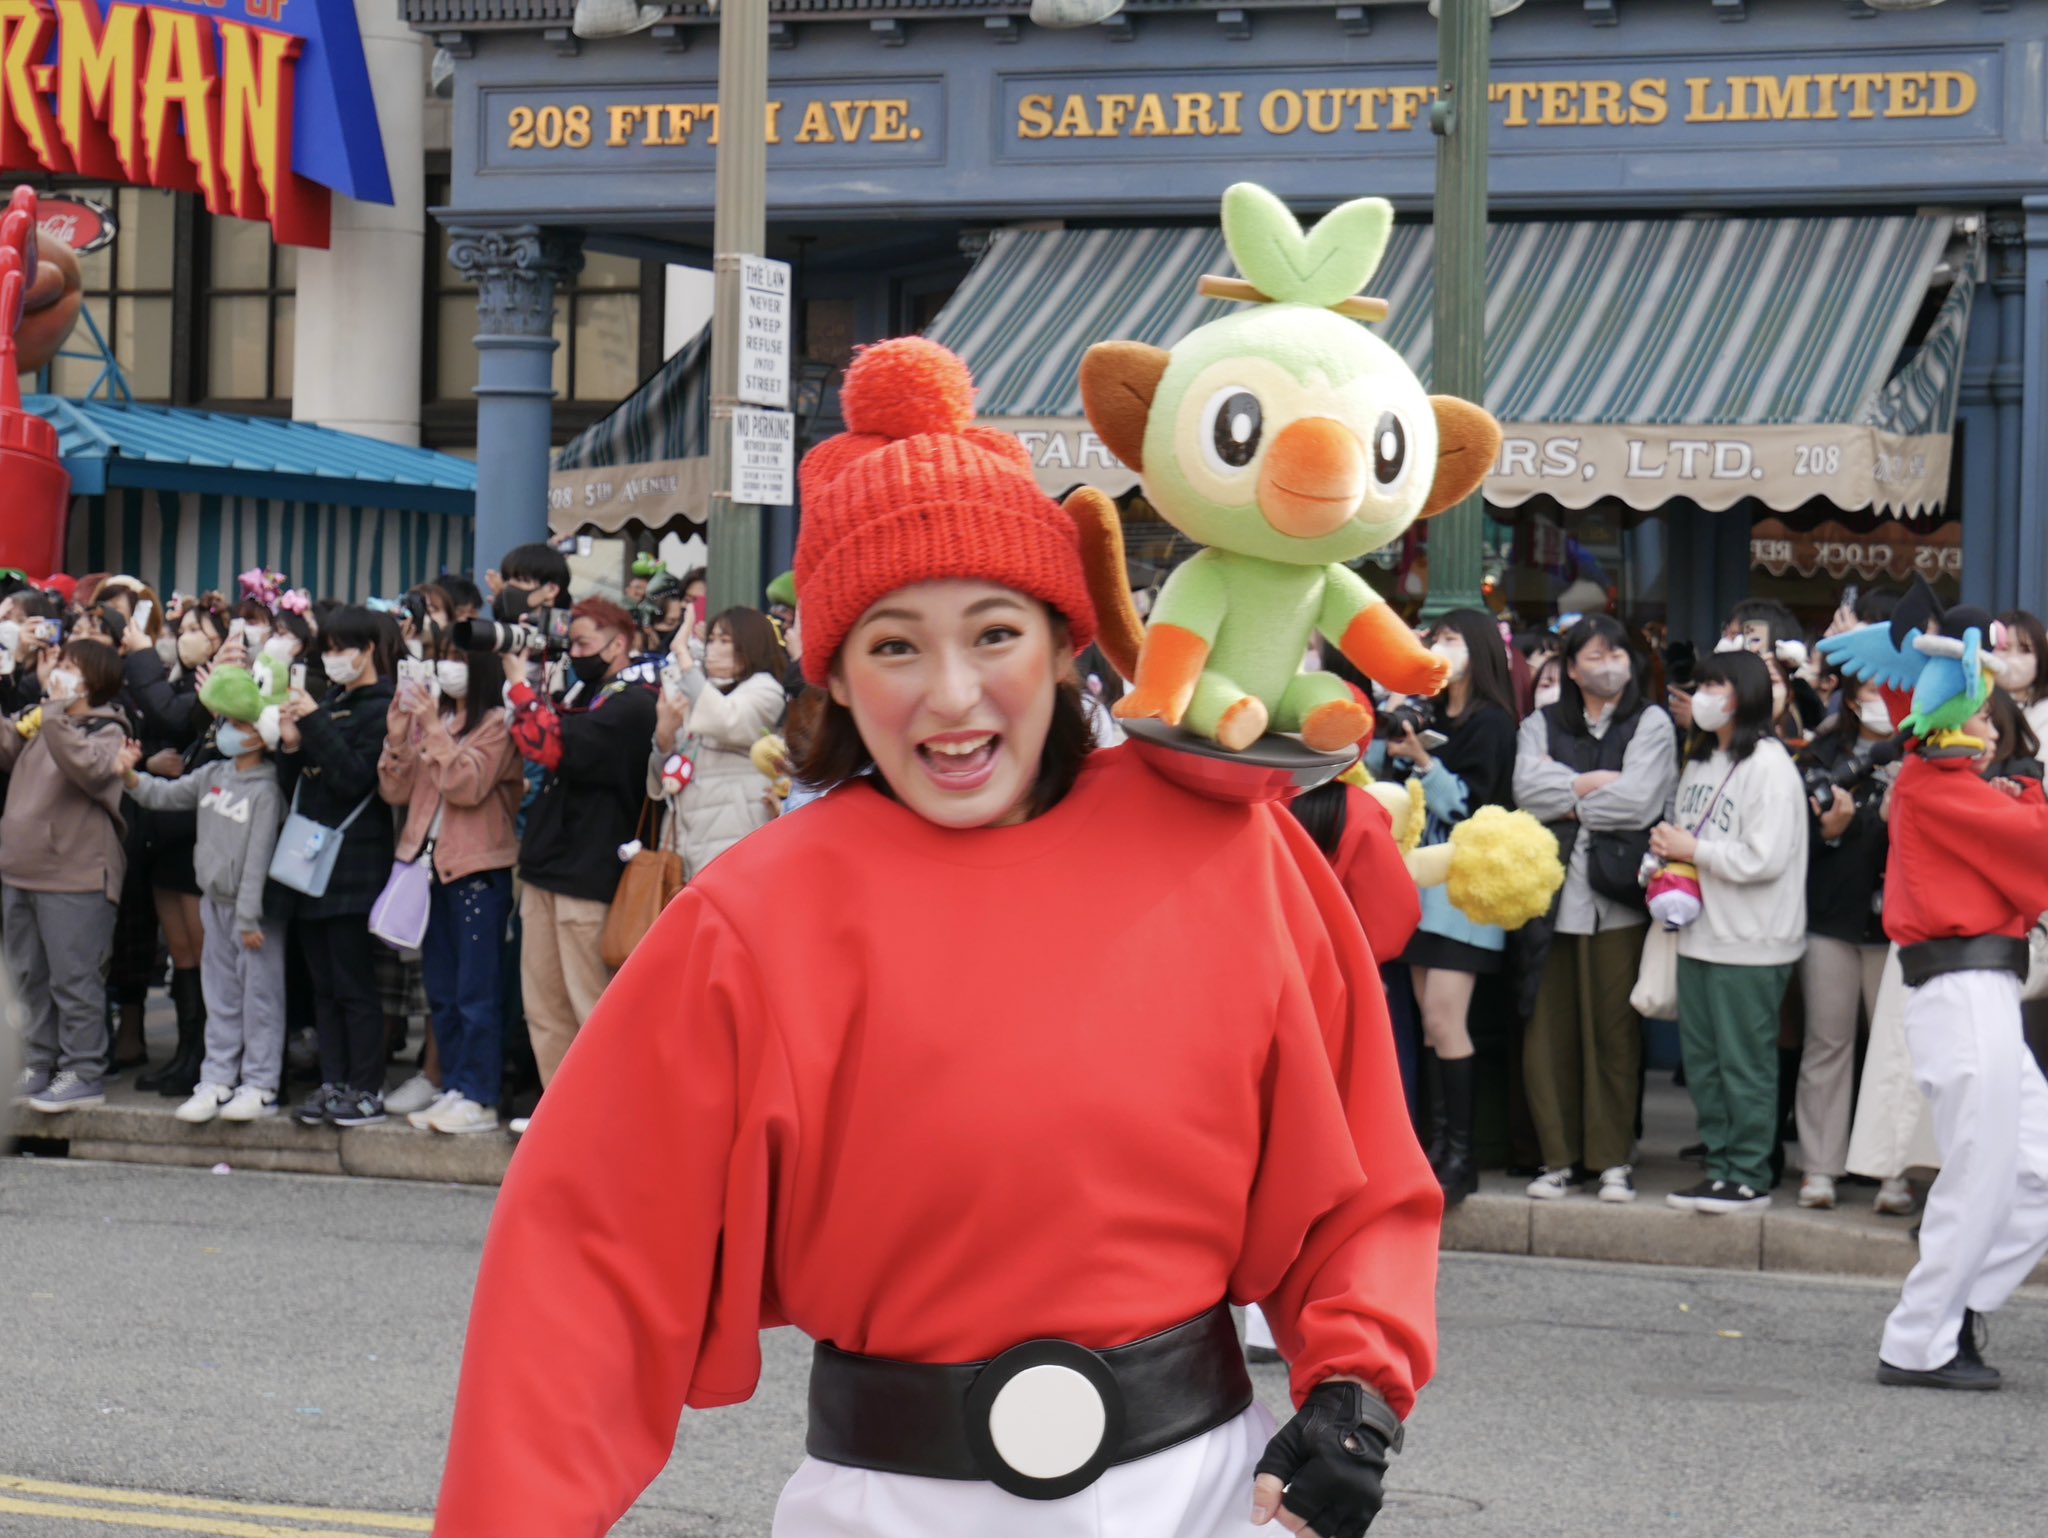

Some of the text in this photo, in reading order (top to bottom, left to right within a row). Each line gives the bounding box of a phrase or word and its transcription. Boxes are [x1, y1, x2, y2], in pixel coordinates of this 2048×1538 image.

[1017, 91, 1243, 138] SAFARI
[1685, 71, 1977, 123] LIMITED
[508, 105, 592, 149] 208
[794, 99, 925, 143] AVE.
[745, 265, 763, 285] THE
[750, 295, 780, 313] NEVER
[748, 315, 781, 333] SWEEP
[746, 335, 782, 355] REFUSE
[745, 374, 781, 393] STREET
[736, 414, 790, 441] NO PARKING
[1626, 439, 1765, 480] LTD.
[1794, 445, 1841, 476] 208
[200, 786, 249, 823] FILA
